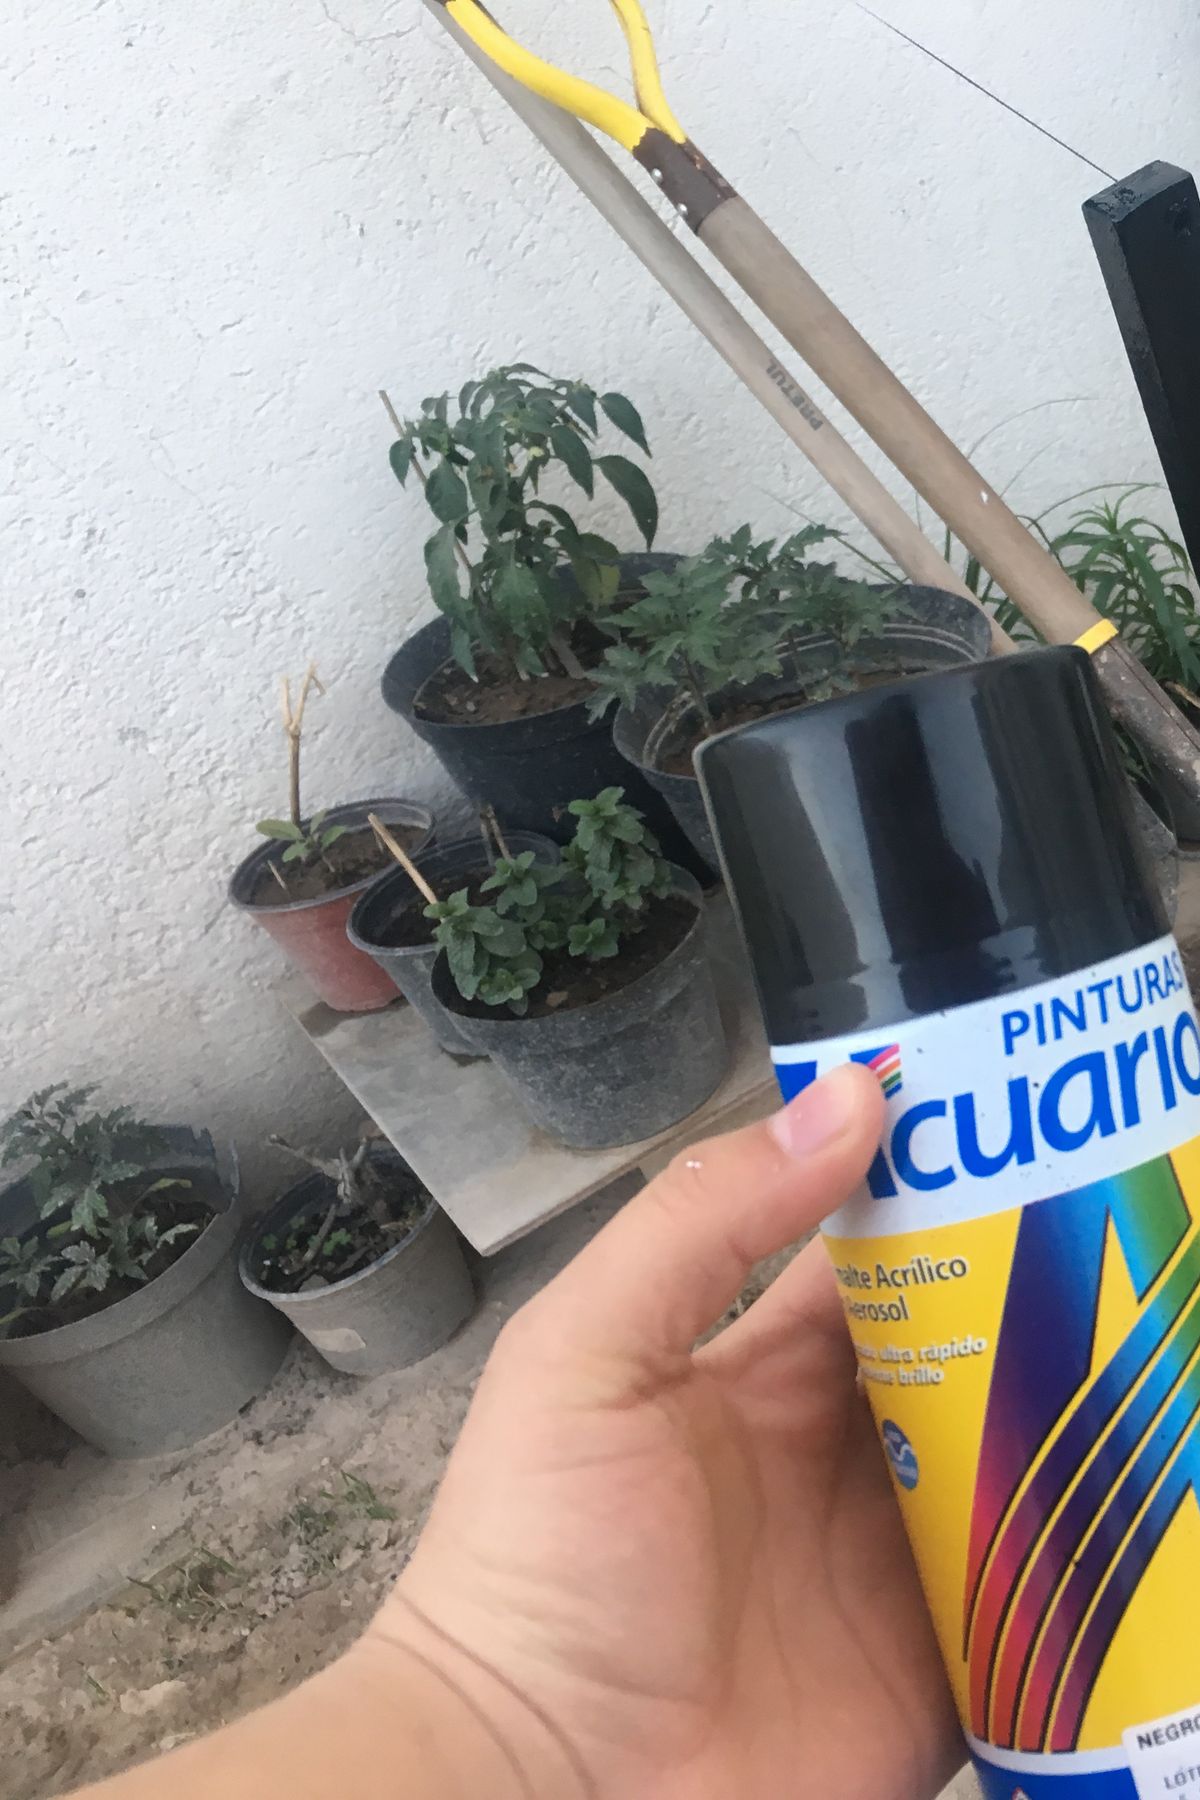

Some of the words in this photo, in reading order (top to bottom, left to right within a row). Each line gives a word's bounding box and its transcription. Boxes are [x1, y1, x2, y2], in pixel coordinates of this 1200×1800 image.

[765, 360, 824, 431] PRETUL
[1000, 949, 1183, 1056] PINTURAS
[876, 1257, 968, 1289] Acrílico
